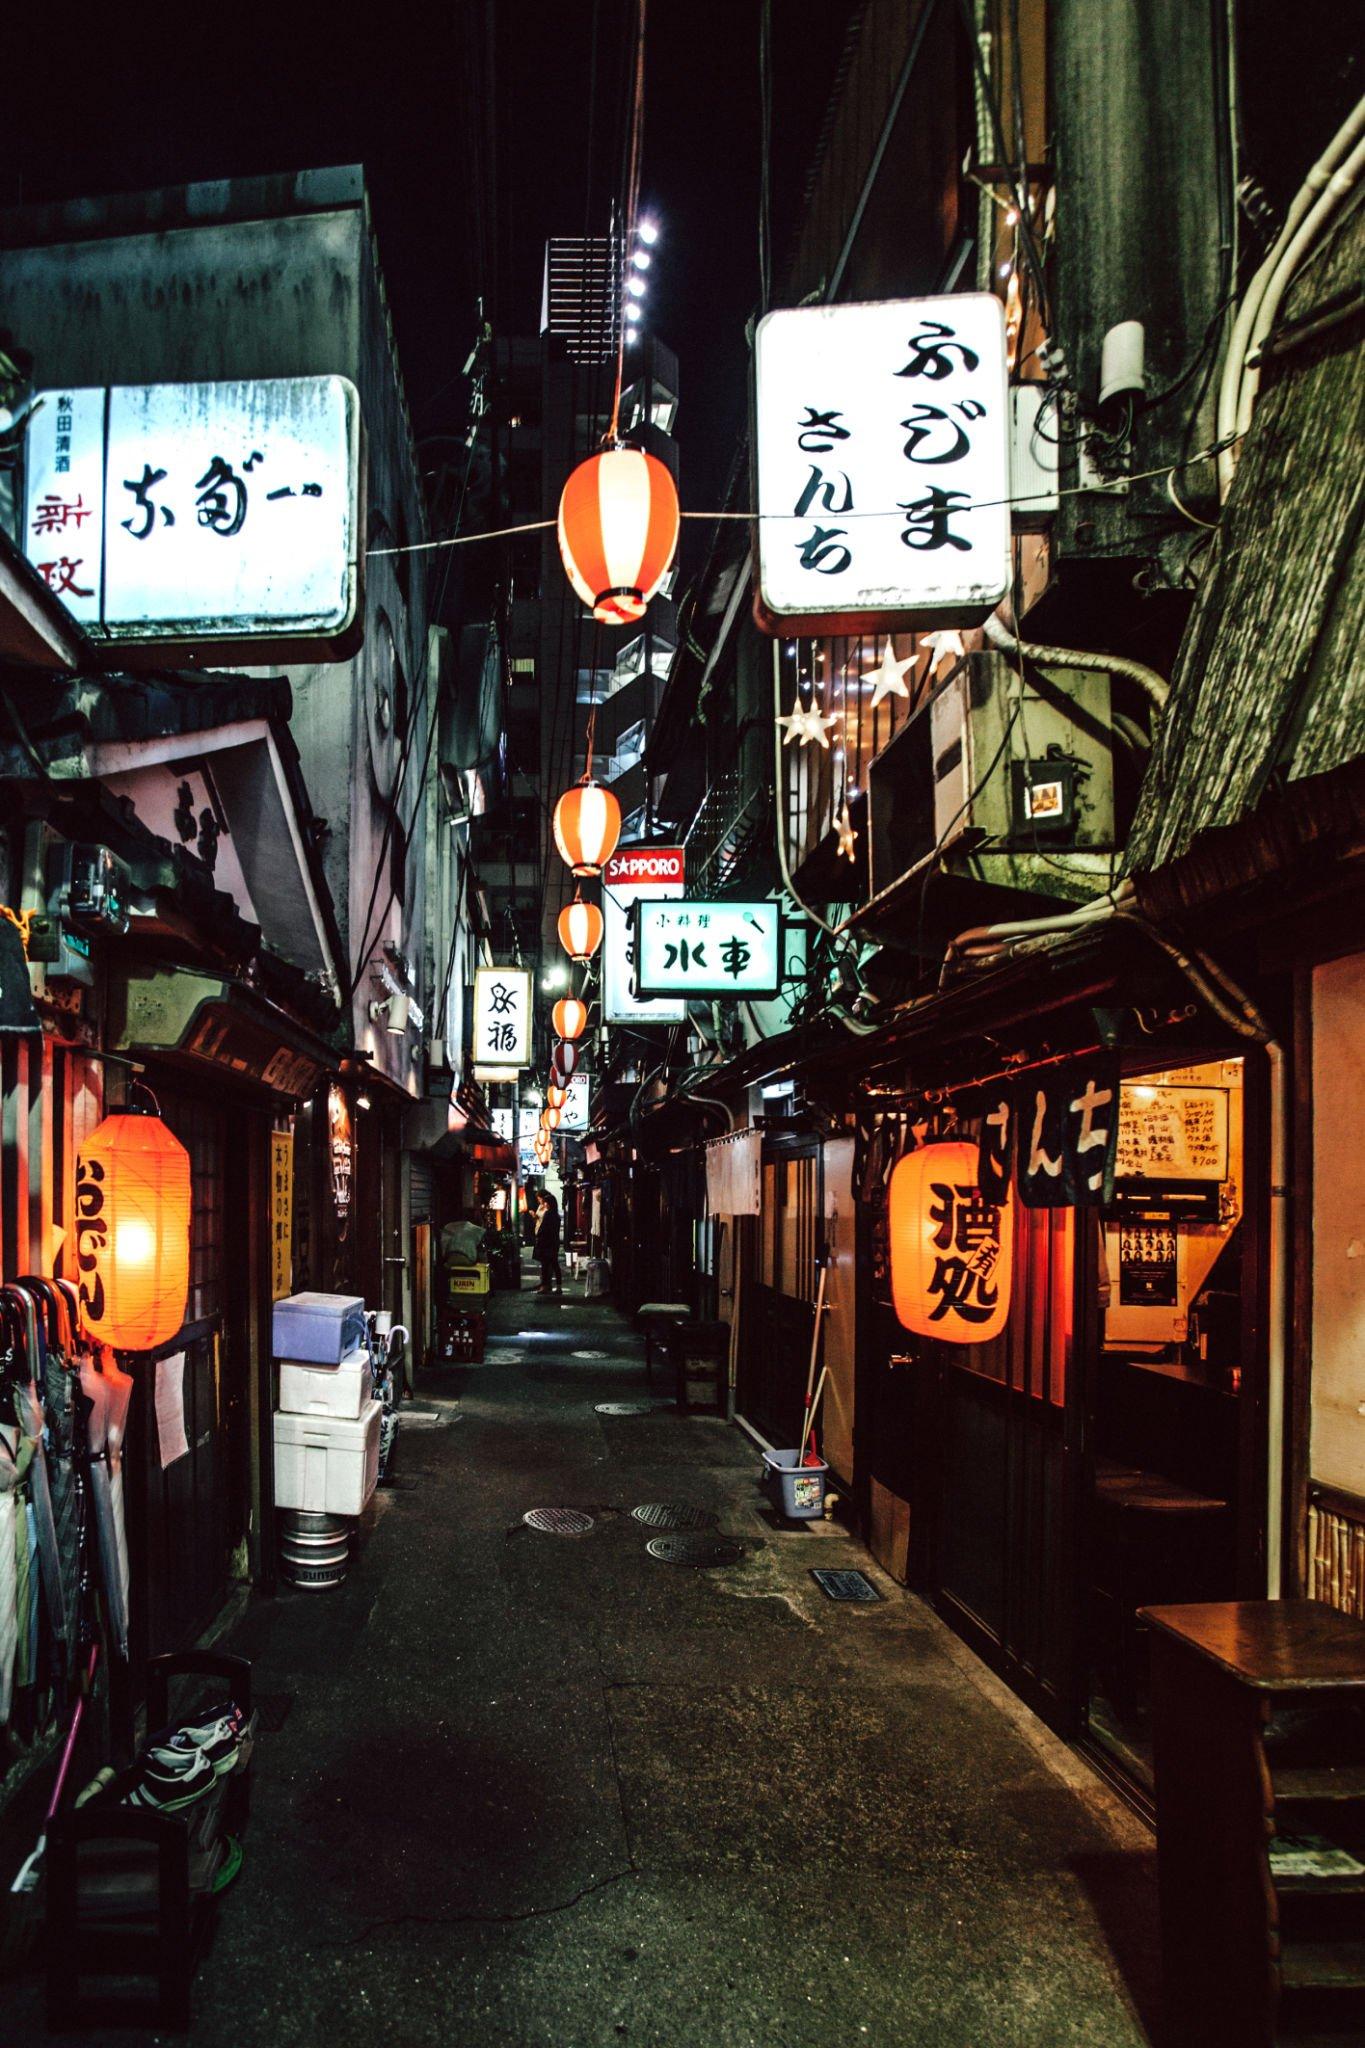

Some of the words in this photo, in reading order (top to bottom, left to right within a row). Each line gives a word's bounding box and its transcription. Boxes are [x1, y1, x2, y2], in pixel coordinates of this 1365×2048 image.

[55, 396, 74, 474] 秋田清酒
[893, 320, 987, 551] ふびま
[793, 405, 855, 576] さんち
[608, 857, 680, 877] SAPPORO
[663, 934, 751, 980] 水車
[453, 1279, 475, 1288] KIRIN
[927, 1183, 1001, 1324] 酒処
